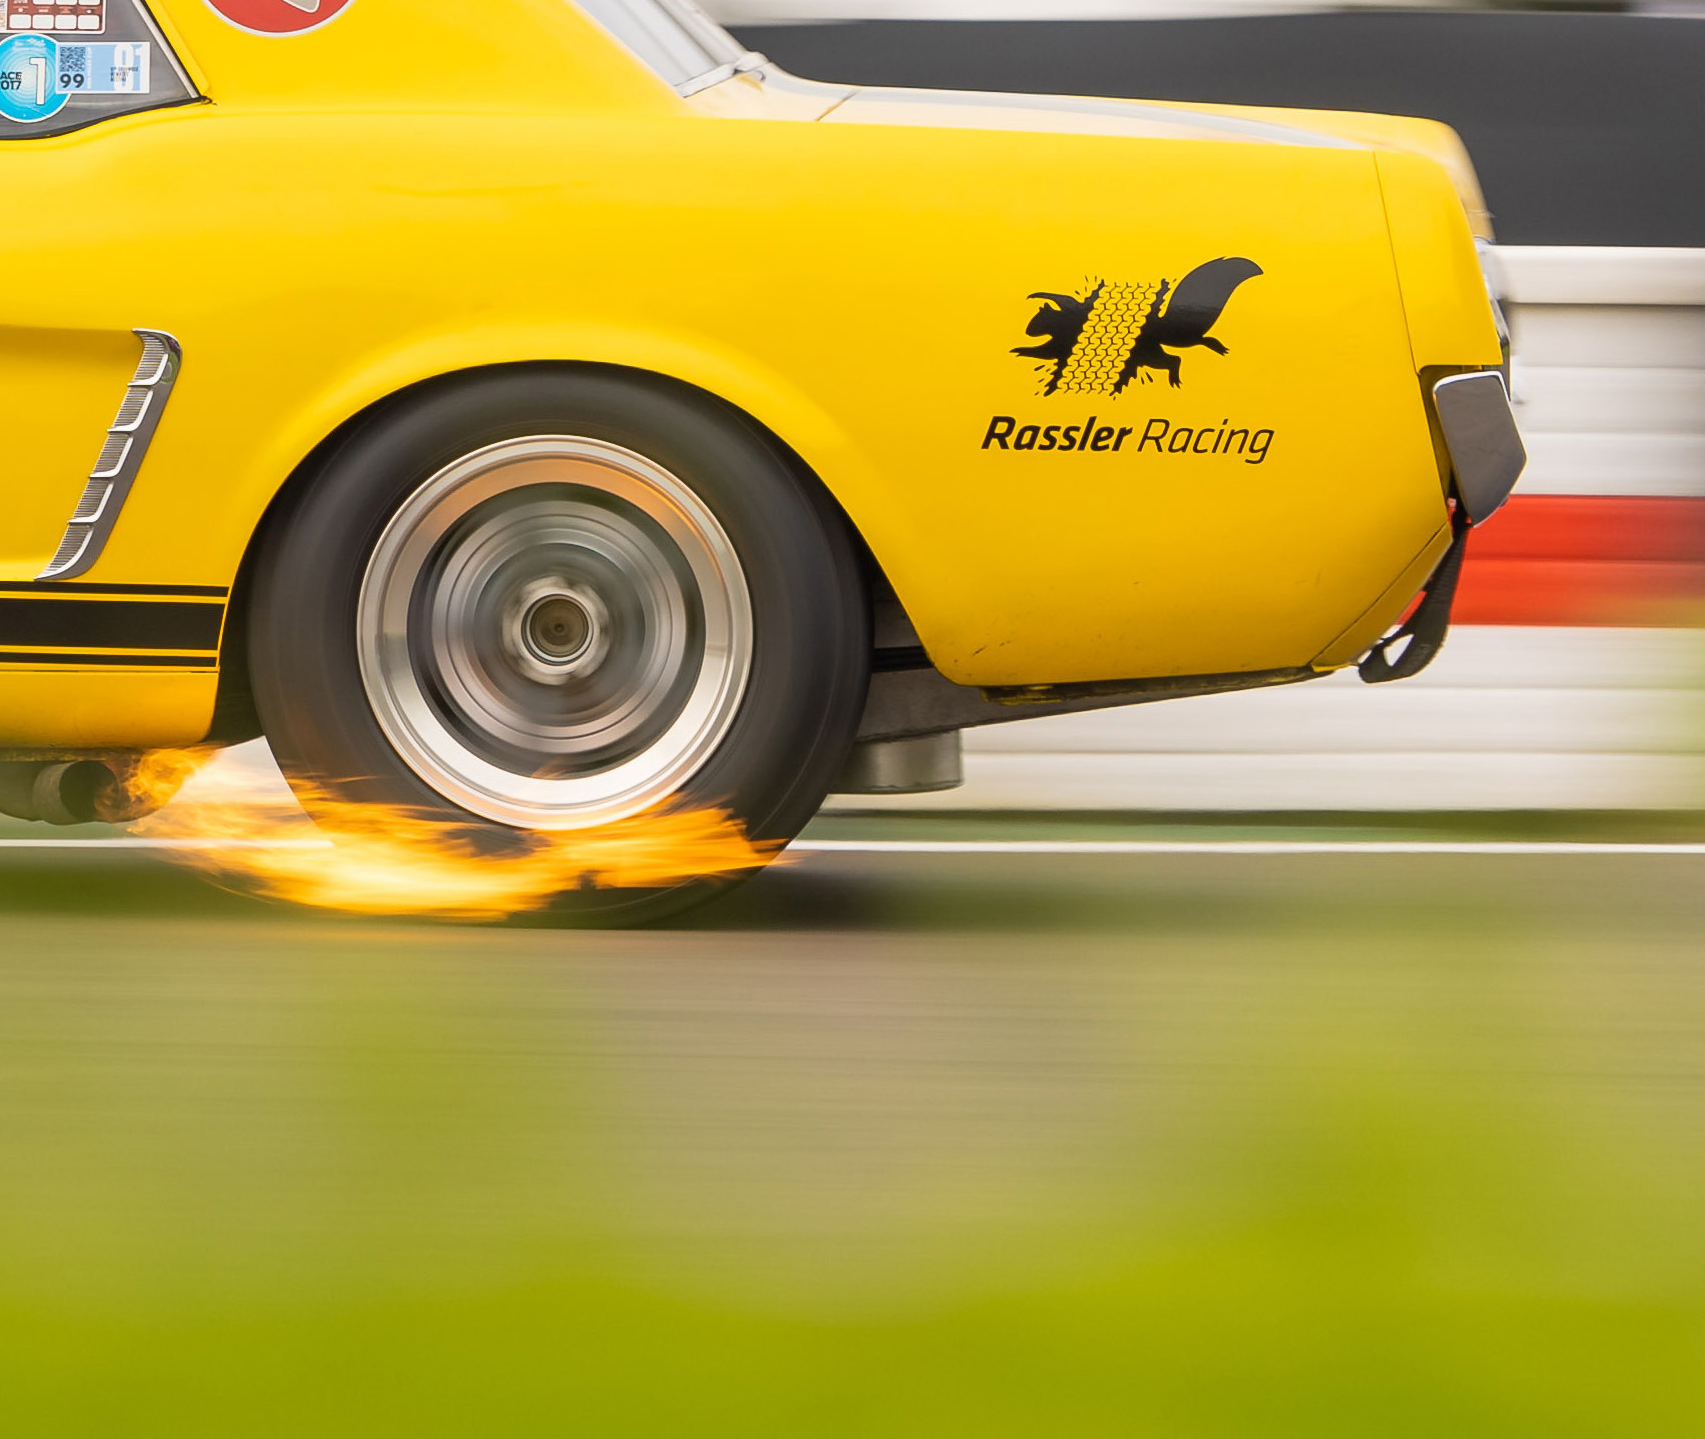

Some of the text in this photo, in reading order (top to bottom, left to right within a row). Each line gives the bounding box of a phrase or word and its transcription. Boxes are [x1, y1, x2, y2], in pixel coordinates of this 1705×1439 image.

[60, 73, 85, 89] 99
[981, 416, 1275, 464] Rassler Racing
